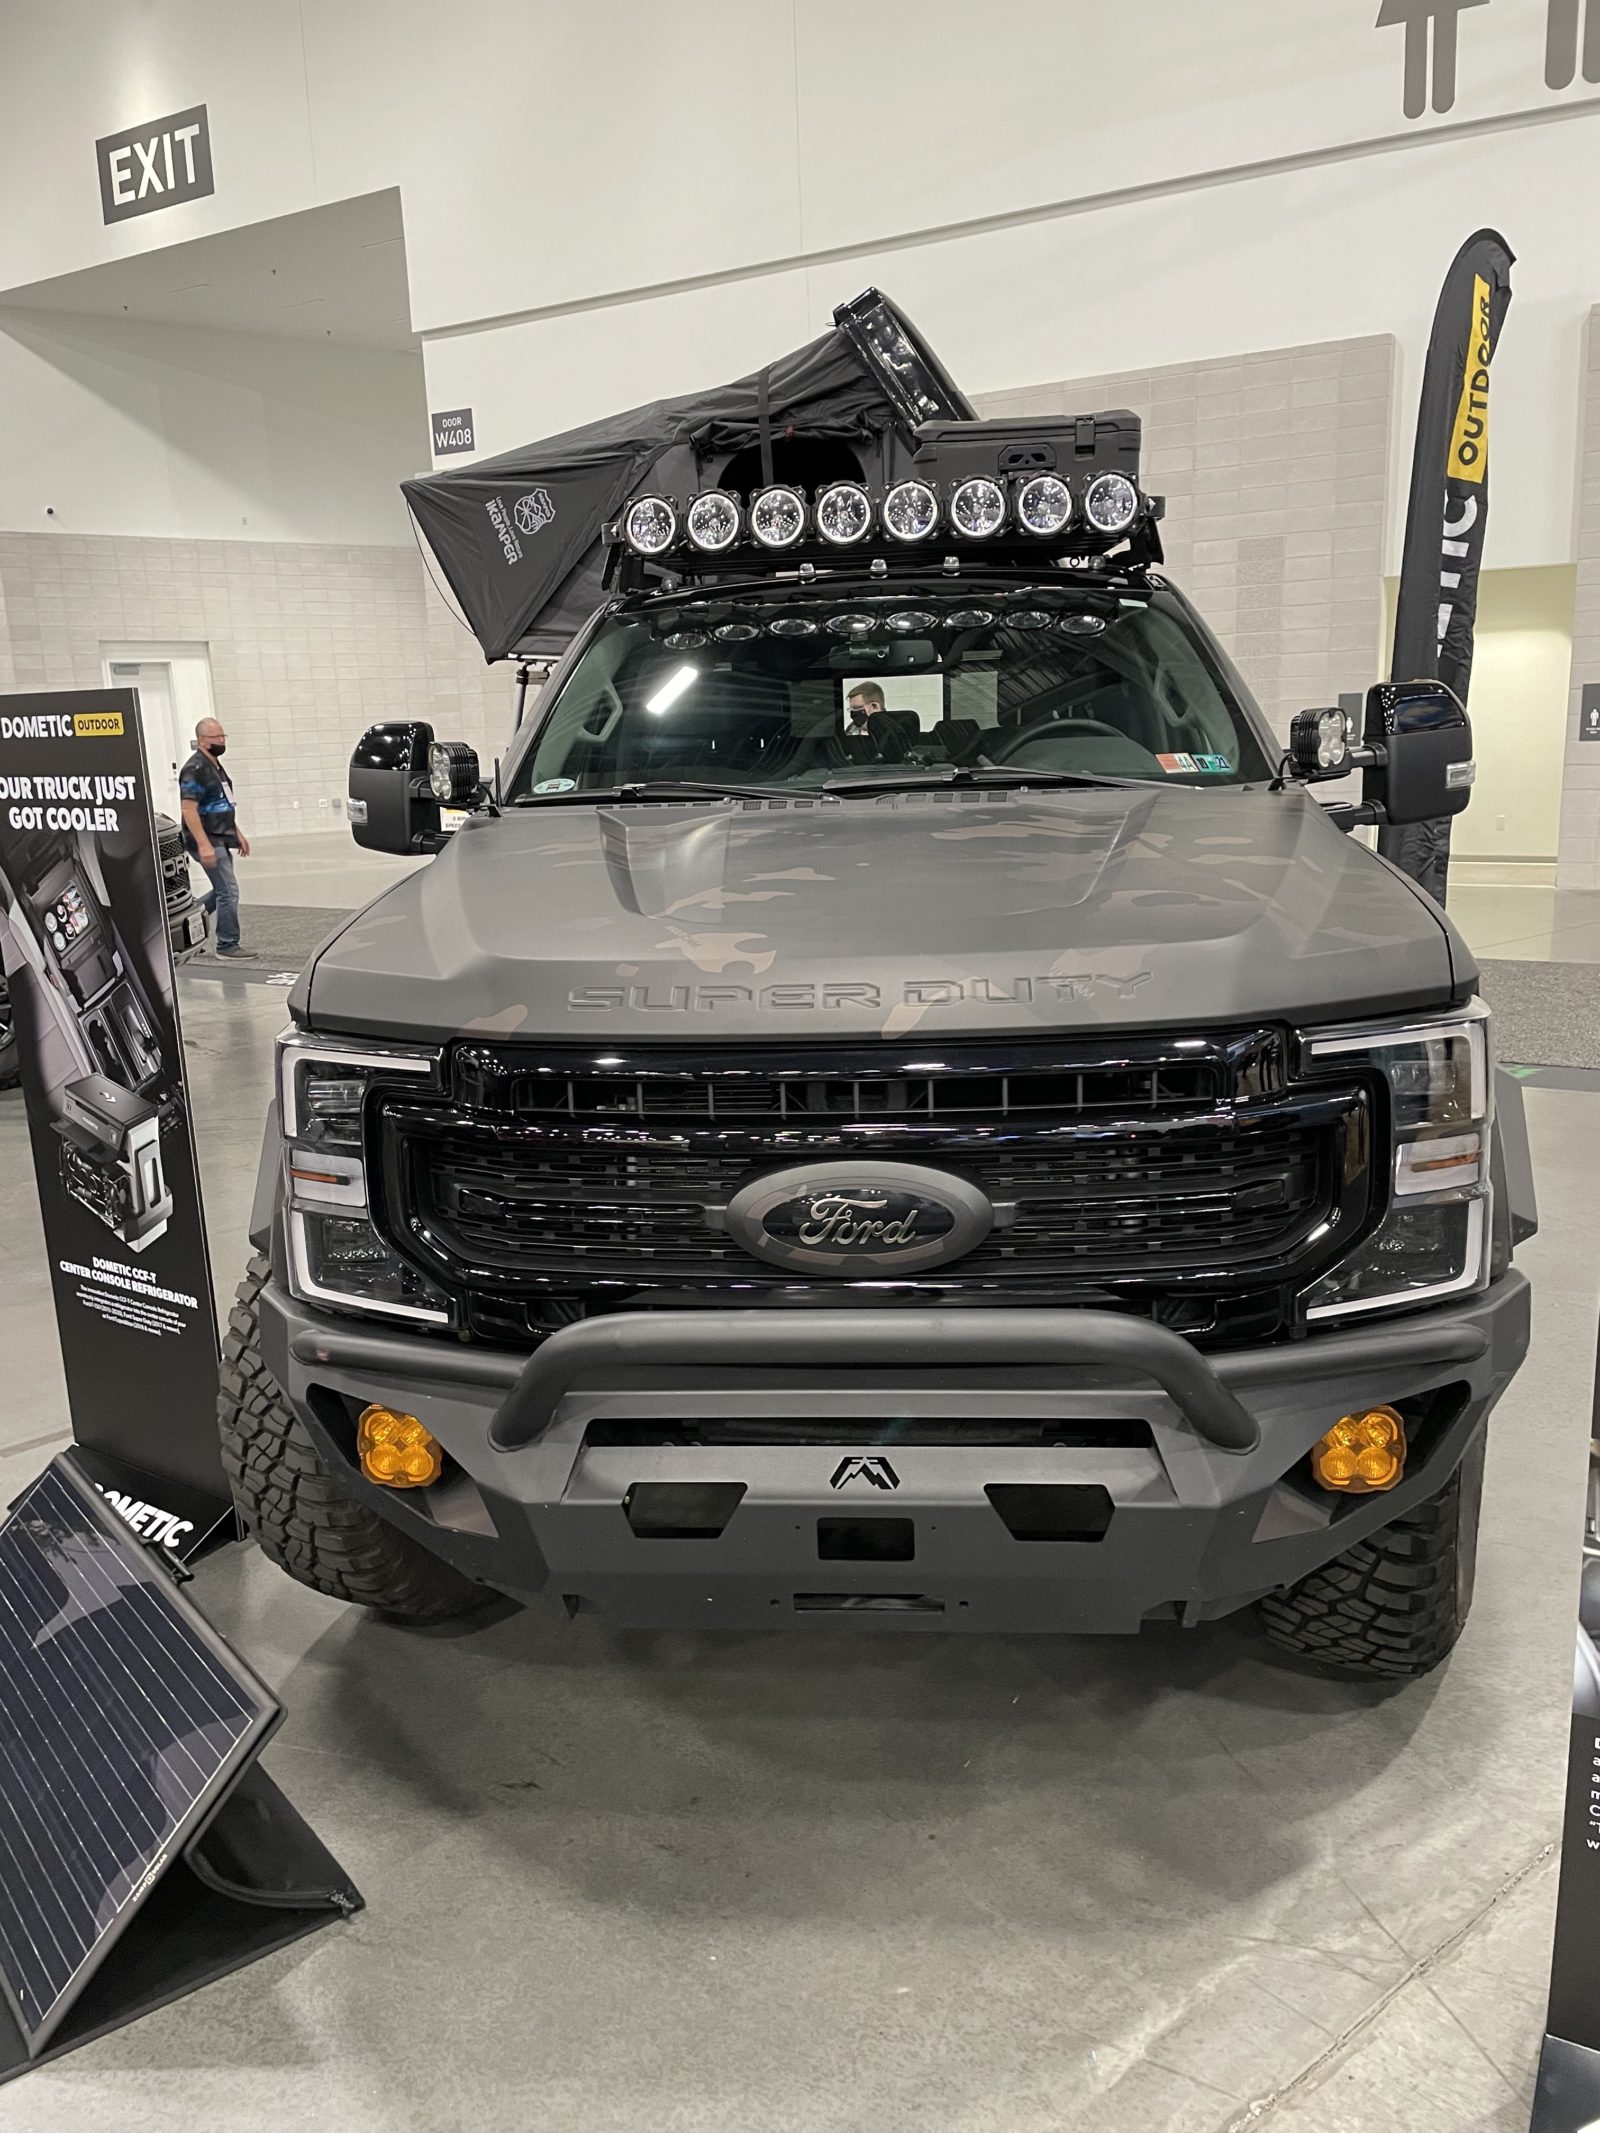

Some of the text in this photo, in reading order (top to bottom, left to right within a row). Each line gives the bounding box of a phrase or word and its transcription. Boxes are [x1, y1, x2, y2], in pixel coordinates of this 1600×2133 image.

[109, 124, 200, 206] EXIT
[1458, 296, 1490, 466] OUTDOOR
[435, 428, 472, 449] W408
[442, 416, 462, 428] DOOR
[1, 714, 121, 739] DOMETIC OUTDOOR
[33, 776, 94, 801] TRUCK
[94, 776, 136, 805] JUST
[9, 808, 120, 832] GOT COOLER
[567, 981, 882, 1013] SUPER
[903, 971, 1154, 1008] DUTY
[799, 1196, 918, 1246] Ford
[60, 1260, 92, 1280] CENTER
[91, 1269, 132, 1291] CONSOLE
[131, 1281, 199, 1310] REFRIGERATOR
[92, 1256, 157, 1284] DOMETIC CCF-T
[94, 1482, 194, 1548] OMETIC
